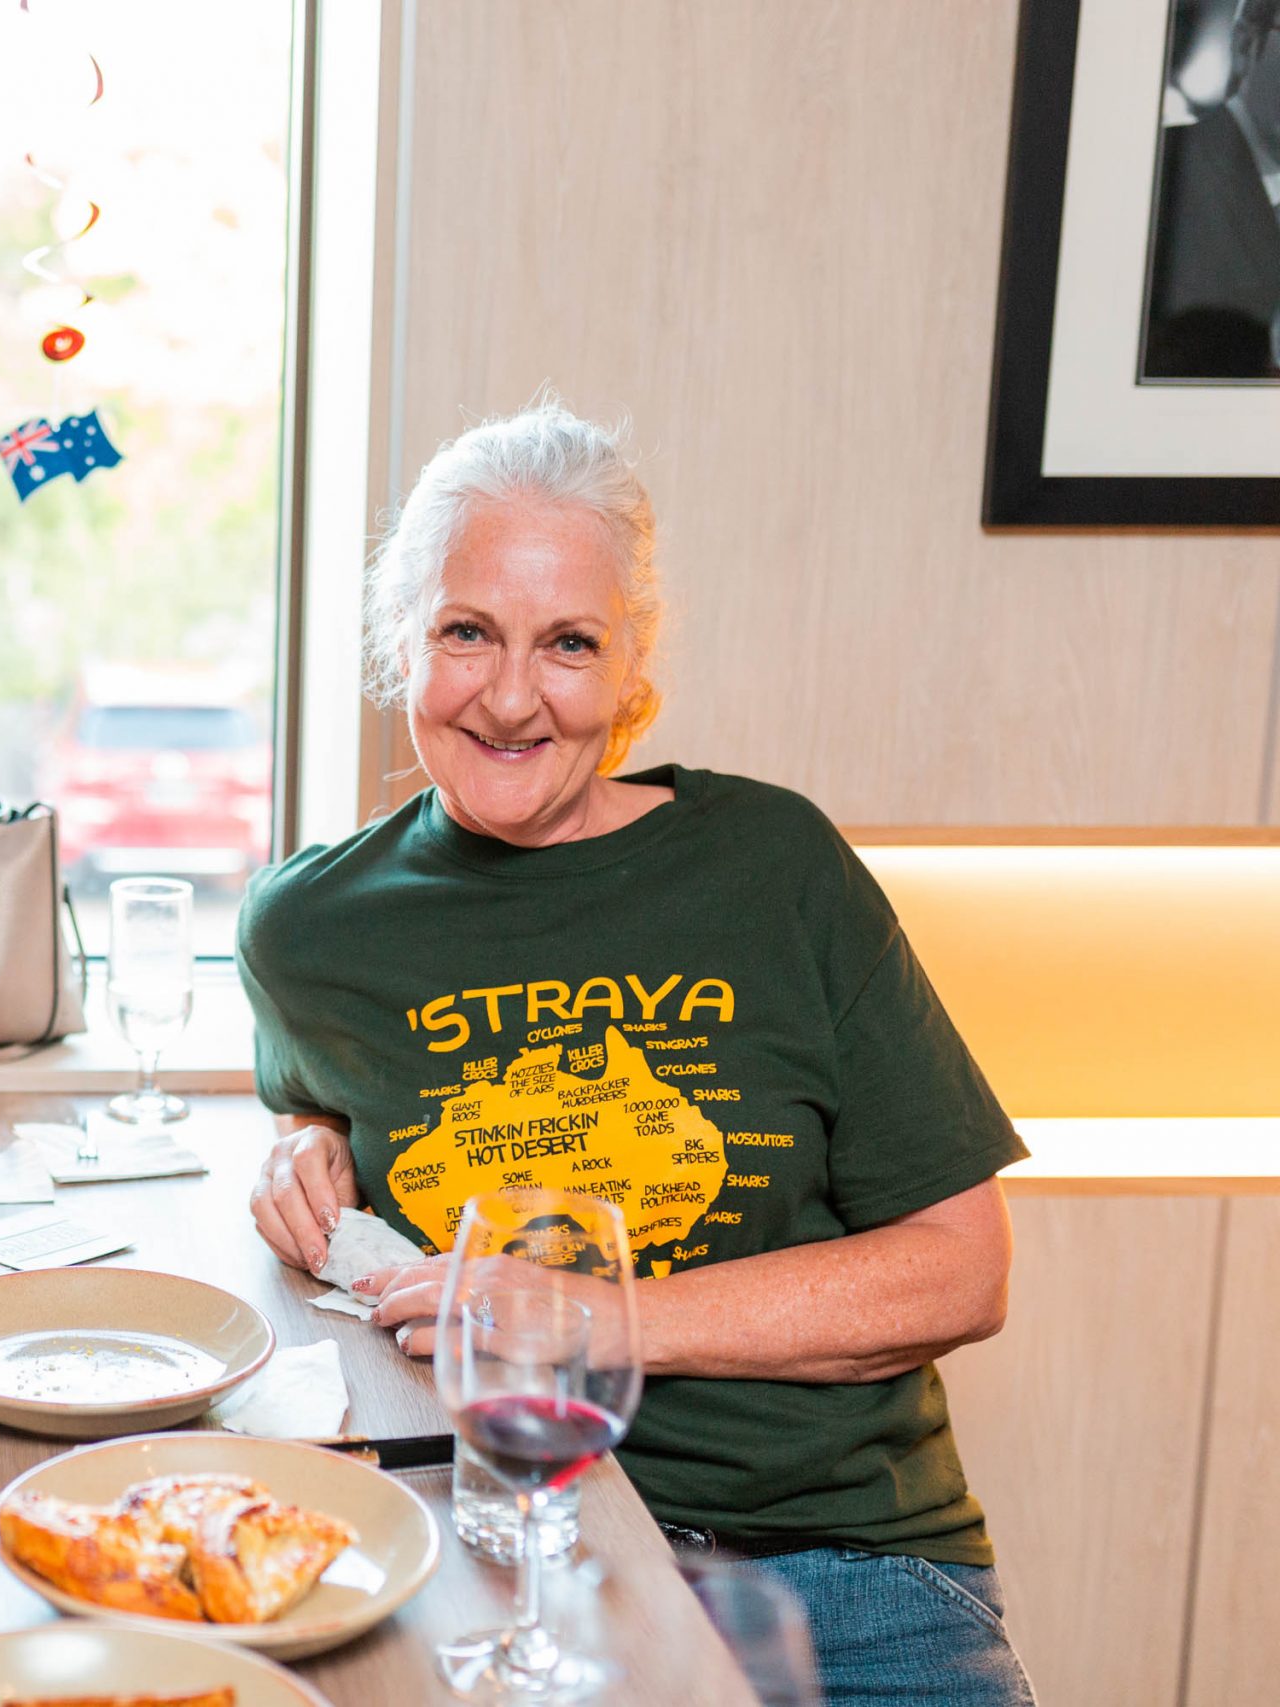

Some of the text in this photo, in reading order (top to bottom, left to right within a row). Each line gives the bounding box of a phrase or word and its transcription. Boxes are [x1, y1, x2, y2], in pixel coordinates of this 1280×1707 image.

[406, 974, 735, 1053] 'STRAYA
[527, 1023, 583, 1043] CYCLONES
[622, 1022, 668, 1032] SHARKS
[645, 1036, 709, 1050] STINGRAYS
[567, 1043, 604, 1062] KILLER
[463, 1056, 498, 1073] KILLER
[511, 1061, 554, 1079] MOZZIES
[569, 1055, 605, 1074] CROCS
[656, 1062, 717, 1077] CYCLONES
[462, 1068, 498, 1081] CROCS
[510, 1073, 556, 1088] THE SIZE
[419, 1083, 462, 1098] SHARKS
[509, 1084, 554, 1099] OF CARS
[557, 1077, 630, 1100] BACKPACKER
[692, 1088, 741, 1102] SHARKS
[451, 1100, 483, 1112] GIANT
[561, 1088, 627, 1109] MURDERERS
[451, 1111, 480, 1122] ROOS
[636, 1110, 669, 1124] CANE
[389, 1123, 428, 1143] SHARKS
[454, 1111, 599, 1148] STINKIN FRICKIN
[634, 1122, 675, 1137] TOADS
[684, 1138, 705, 1151] BIG
[726, 1132, 795, 1148] MOSQUITOES
[466, 1132, 589, 1168] HOT DESERT
[572, 1156, 613, 1173] A ROCK
[671, 1151, 720, 1165] SPIDERS
[393, 1162, 447, 1183] POISONOUS
[502, 1170, 533, 1184] SOME
[401, 1176, 441, 1194] SNAKES
[563, 1178, 632, 1195] MAN-EATING
[644, 1181, 701, 1196] DICKHEAD
[726, 1174, 770, 1188] SHARKS
[640, 1193, 706, 1210] POLITICIANS
